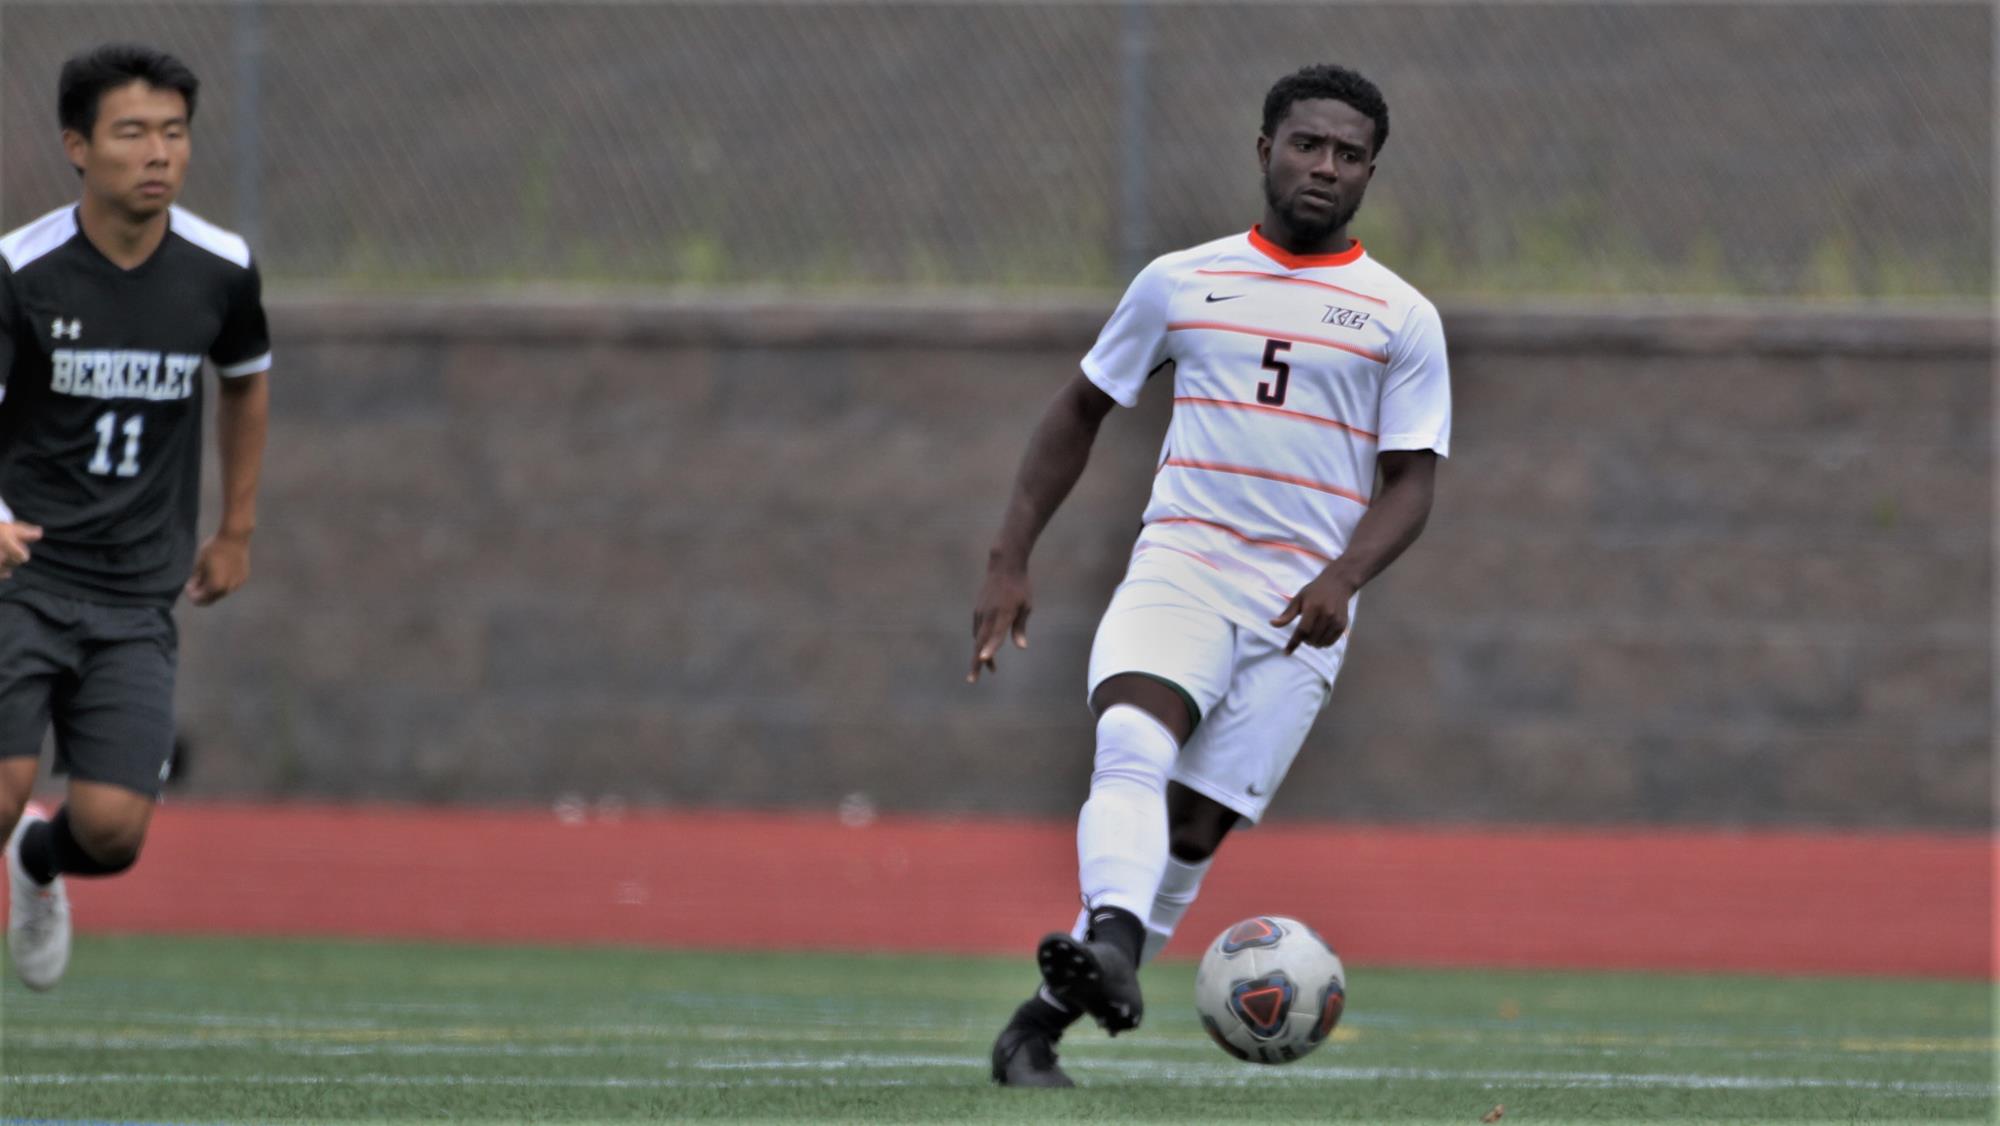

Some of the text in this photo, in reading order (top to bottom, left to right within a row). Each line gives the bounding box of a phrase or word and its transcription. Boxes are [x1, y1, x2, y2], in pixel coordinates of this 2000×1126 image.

[51, 350, 201, 401] BERKELEY
[1256, 338, 1292, 407] 5
[88, 411, 144, 477] 11
